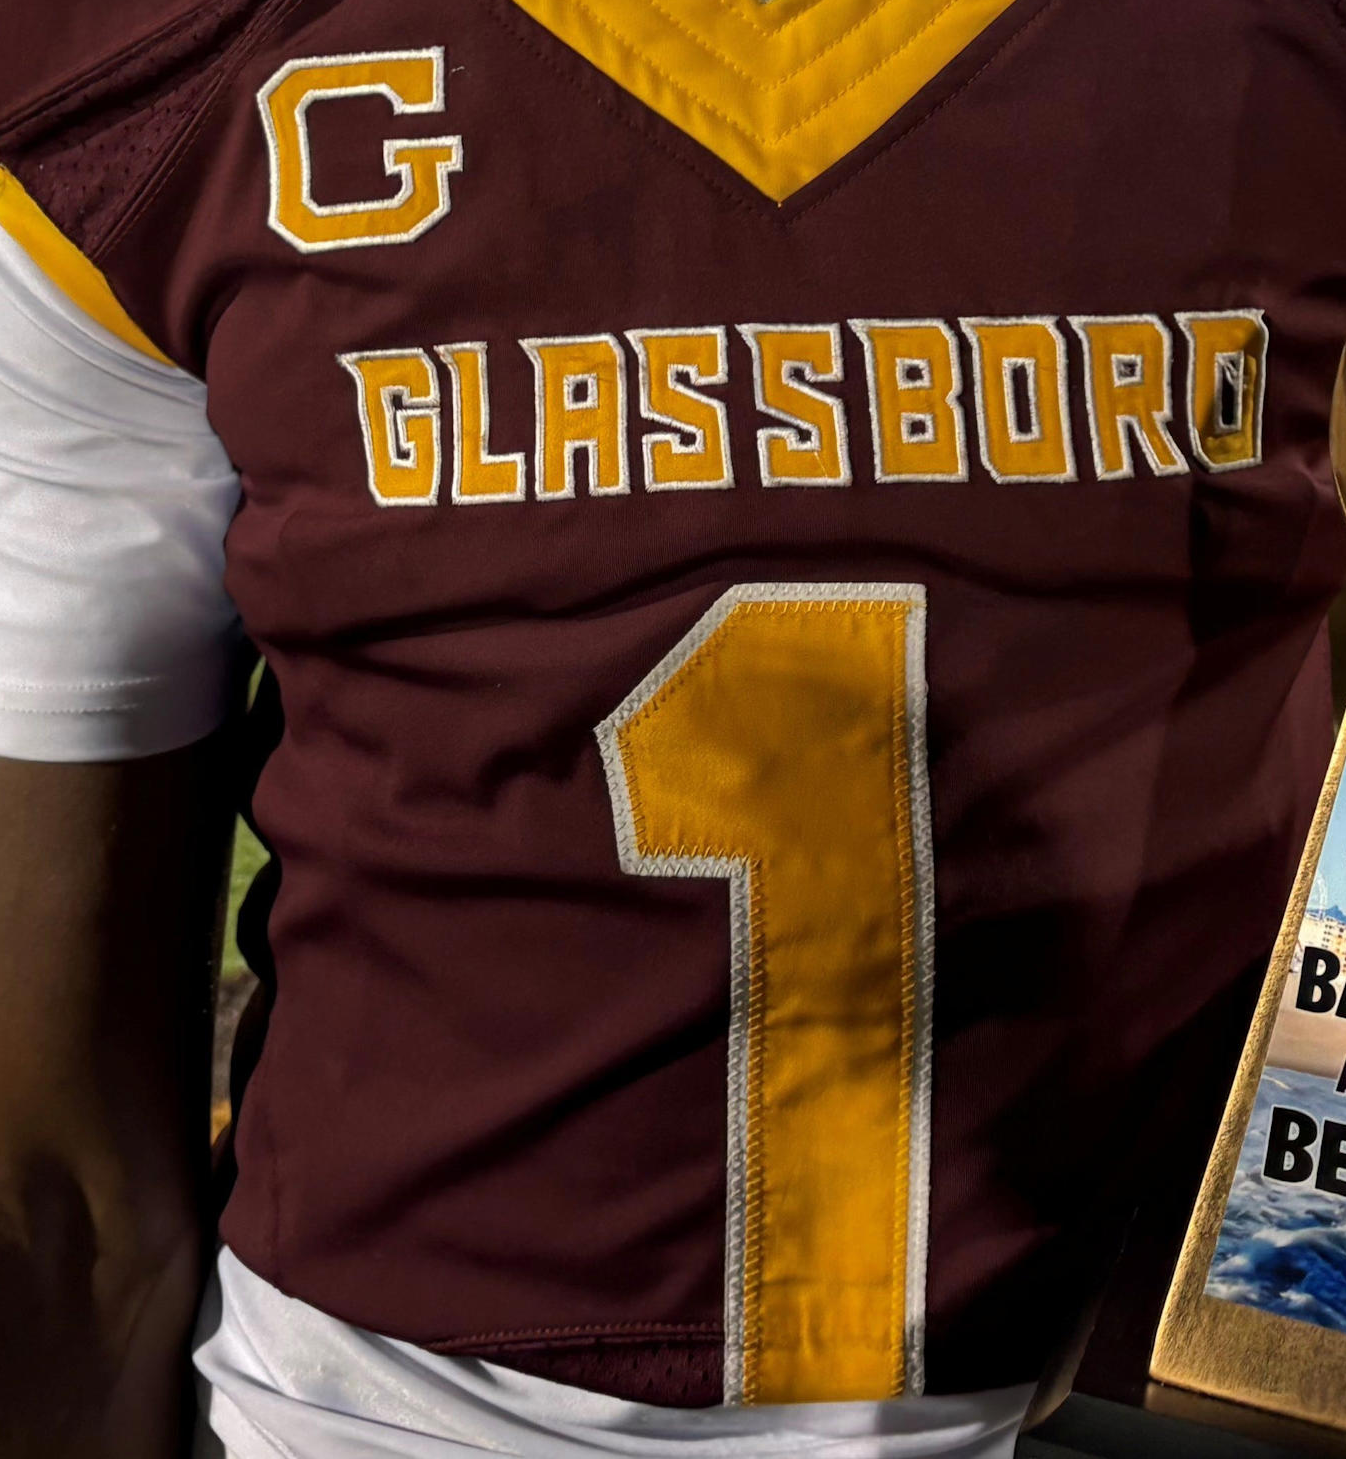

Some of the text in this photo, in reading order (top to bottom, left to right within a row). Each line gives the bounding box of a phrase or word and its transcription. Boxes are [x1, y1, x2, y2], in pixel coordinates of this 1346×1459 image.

[257, 46, 464, 255] G
[336, 308, 1270, 508] GLASSBORO
[593, 582, 935, 1408] 1
